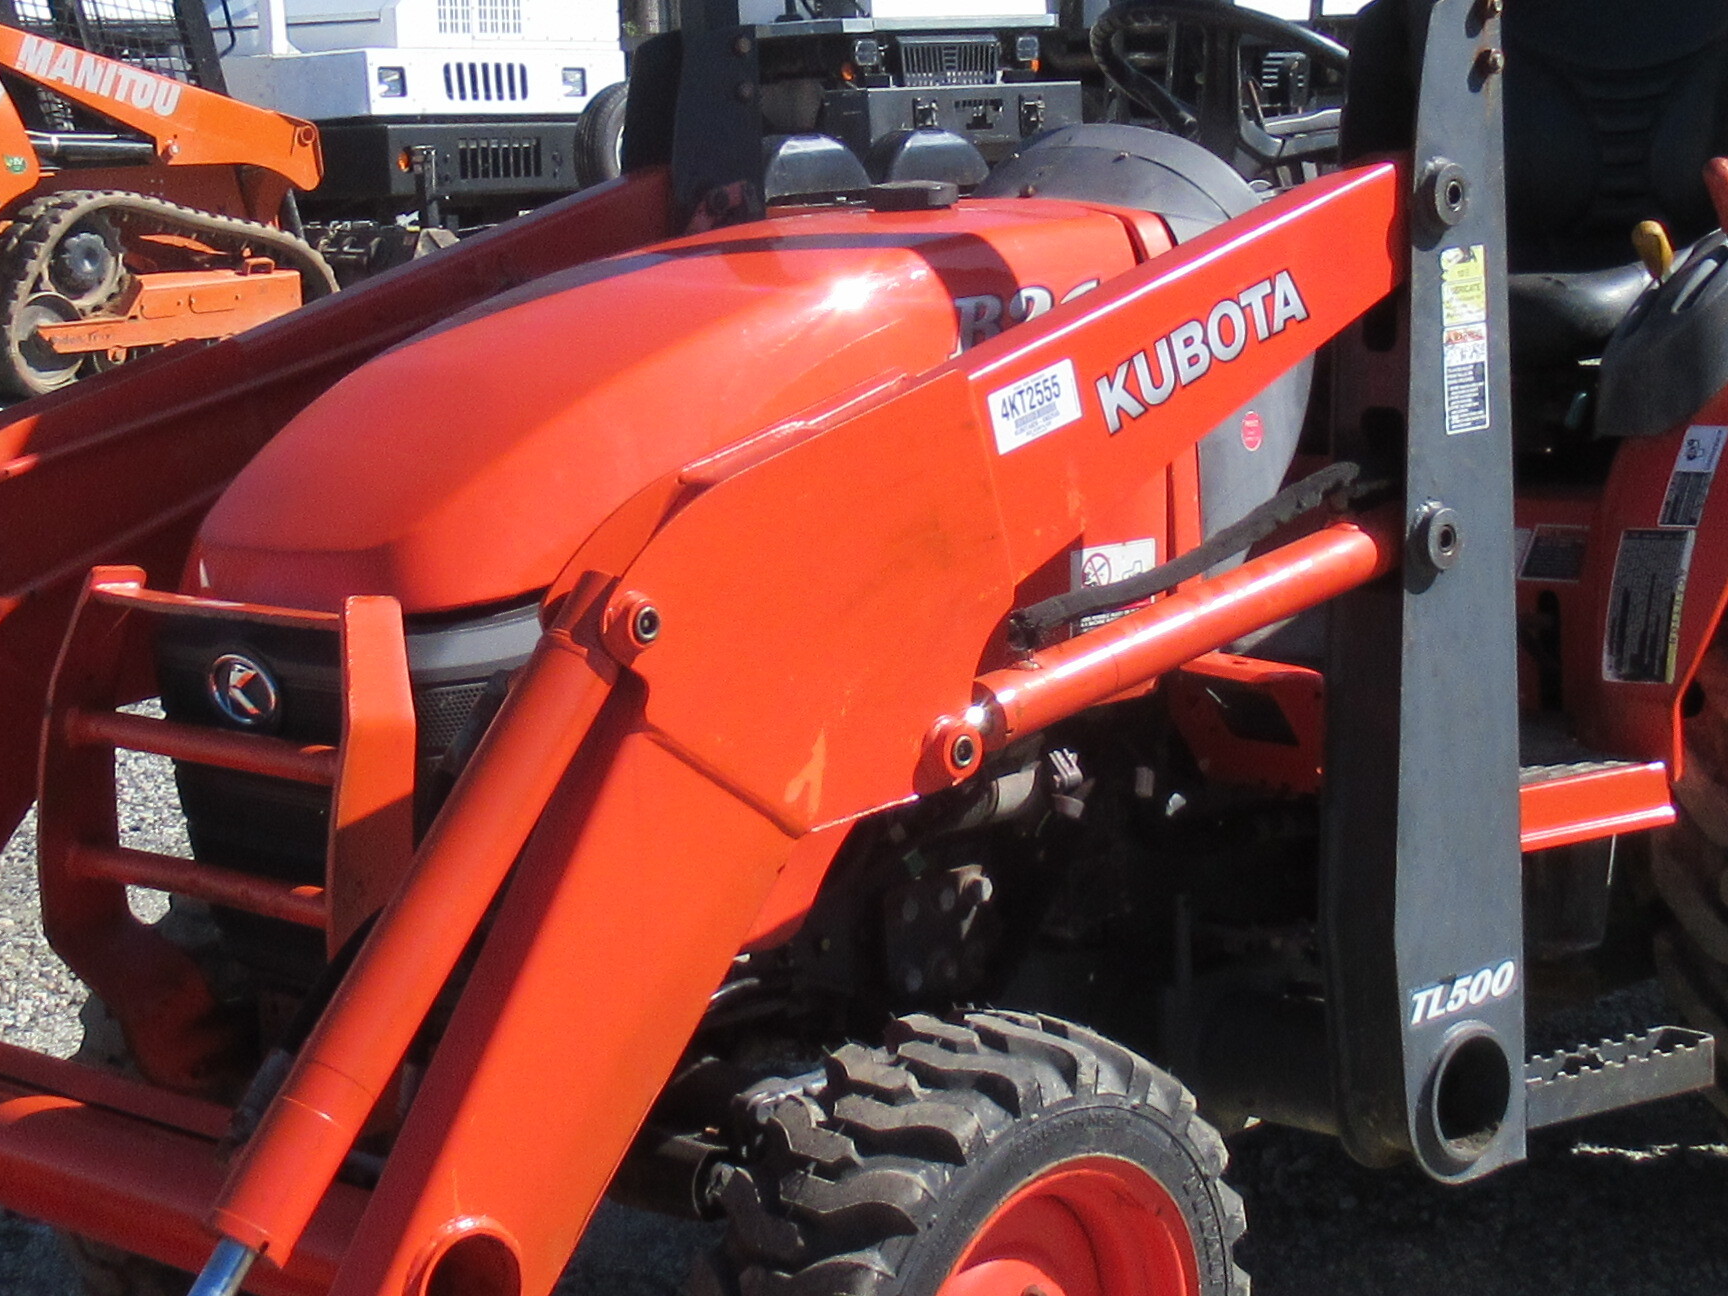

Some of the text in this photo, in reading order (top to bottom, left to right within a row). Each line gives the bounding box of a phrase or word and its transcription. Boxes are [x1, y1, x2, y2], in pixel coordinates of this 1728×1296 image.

[15, 34, 182, 117] MANITOU
[948, 277, 1101, 360] B2
[1095, 268, 1310, 436] KUBOTA
[1000, 373, 1062, 422] 4KT2555
[1410, 959, 1516, 1026] TL500
